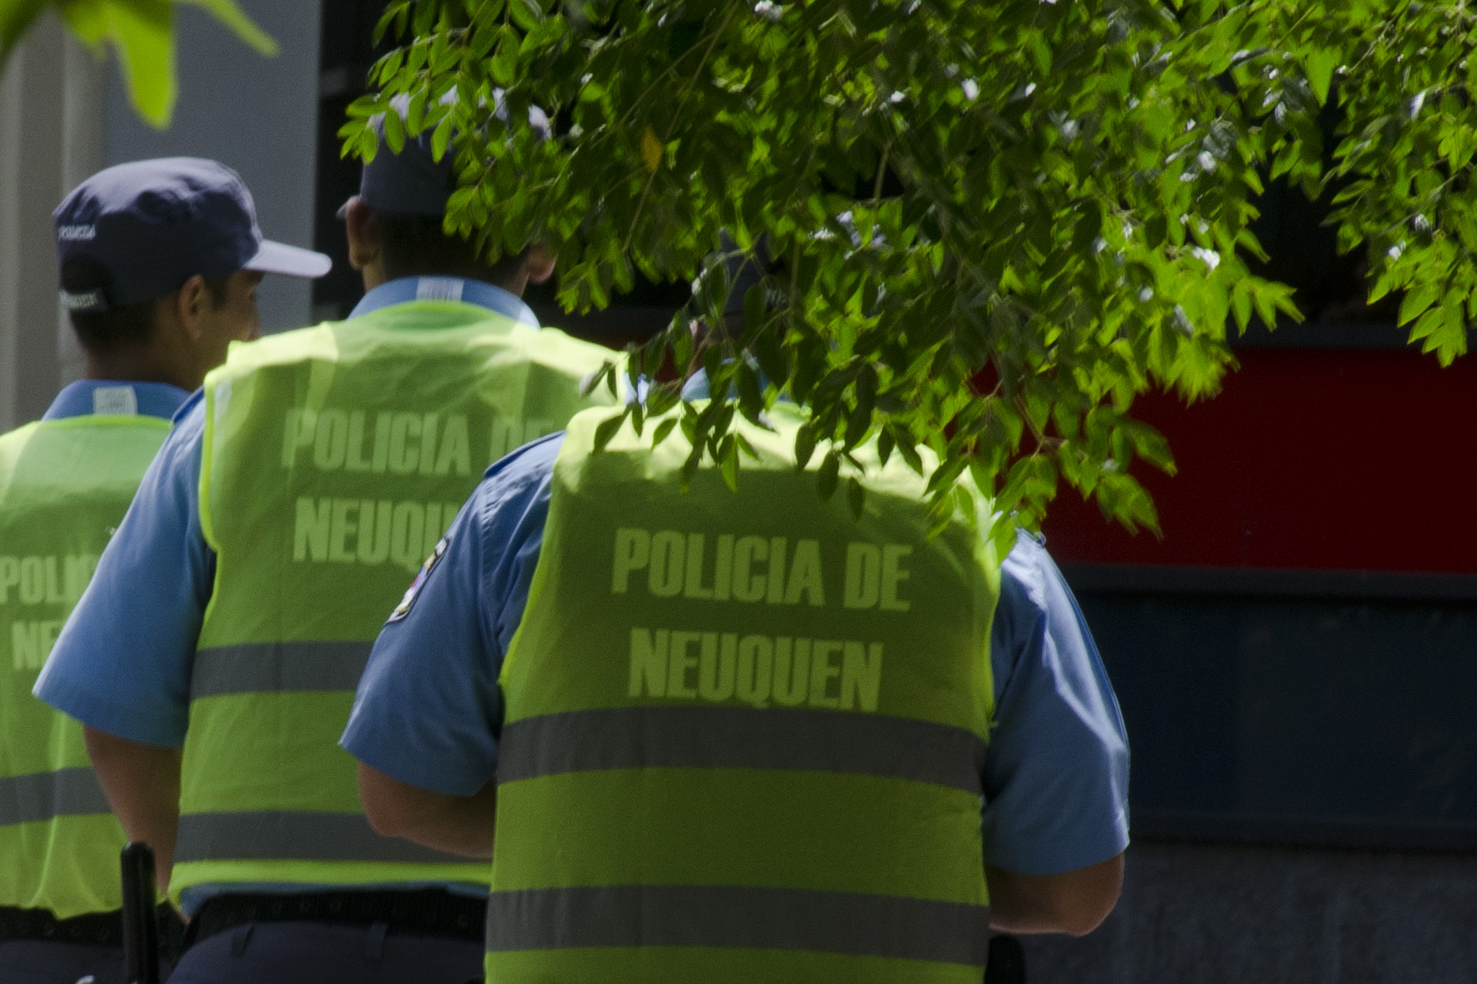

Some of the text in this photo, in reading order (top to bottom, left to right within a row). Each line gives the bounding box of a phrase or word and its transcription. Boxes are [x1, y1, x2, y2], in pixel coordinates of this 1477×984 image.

[281, 407, 471, 475] POLICIA
[611, 527, 913, 612] POLICIA DE
[628, 626, 884, 713] NEUQUEN
